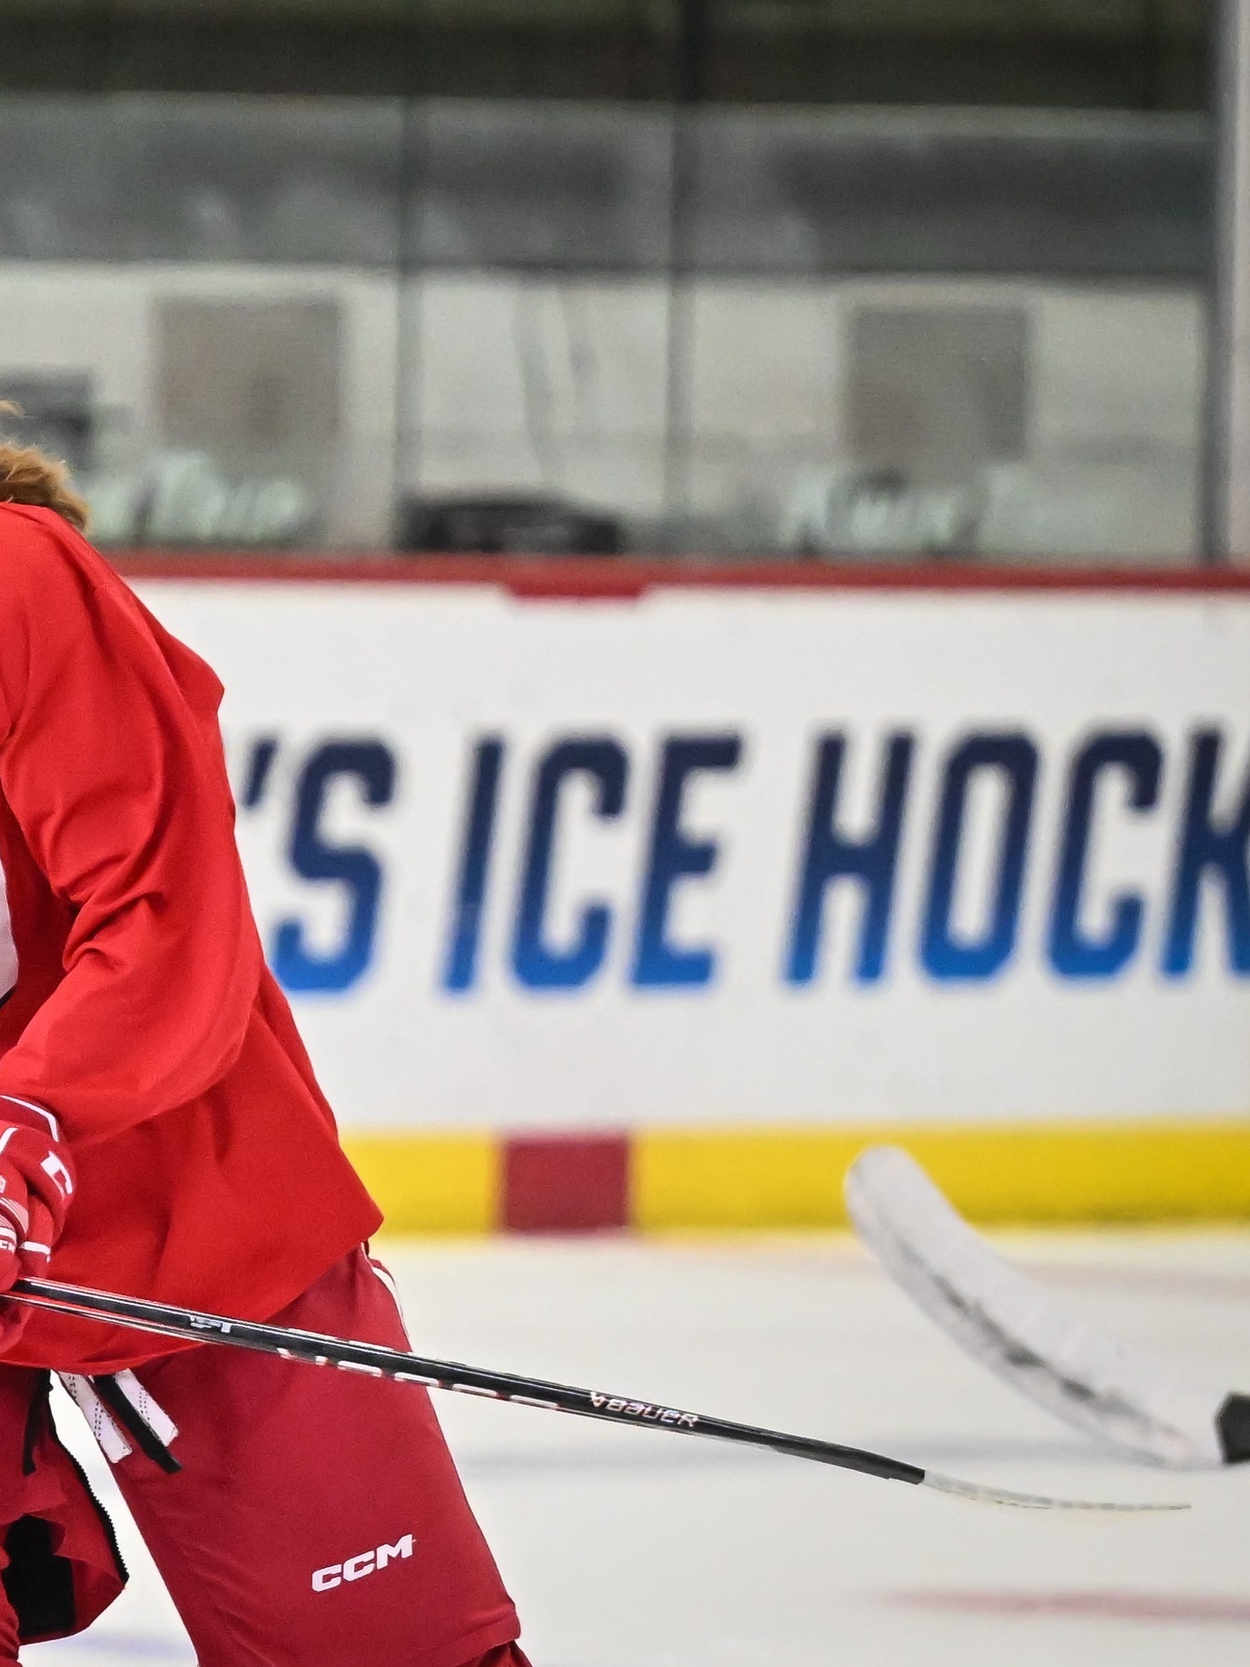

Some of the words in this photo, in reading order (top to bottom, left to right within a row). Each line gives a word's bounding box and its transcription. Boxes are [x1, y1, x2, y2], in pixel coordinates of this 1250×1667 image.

[438, 730, 745, 998] ICE
[605, 1398, 699, 1428] BAUER
[312, 1533, 413, 1593] CCM
